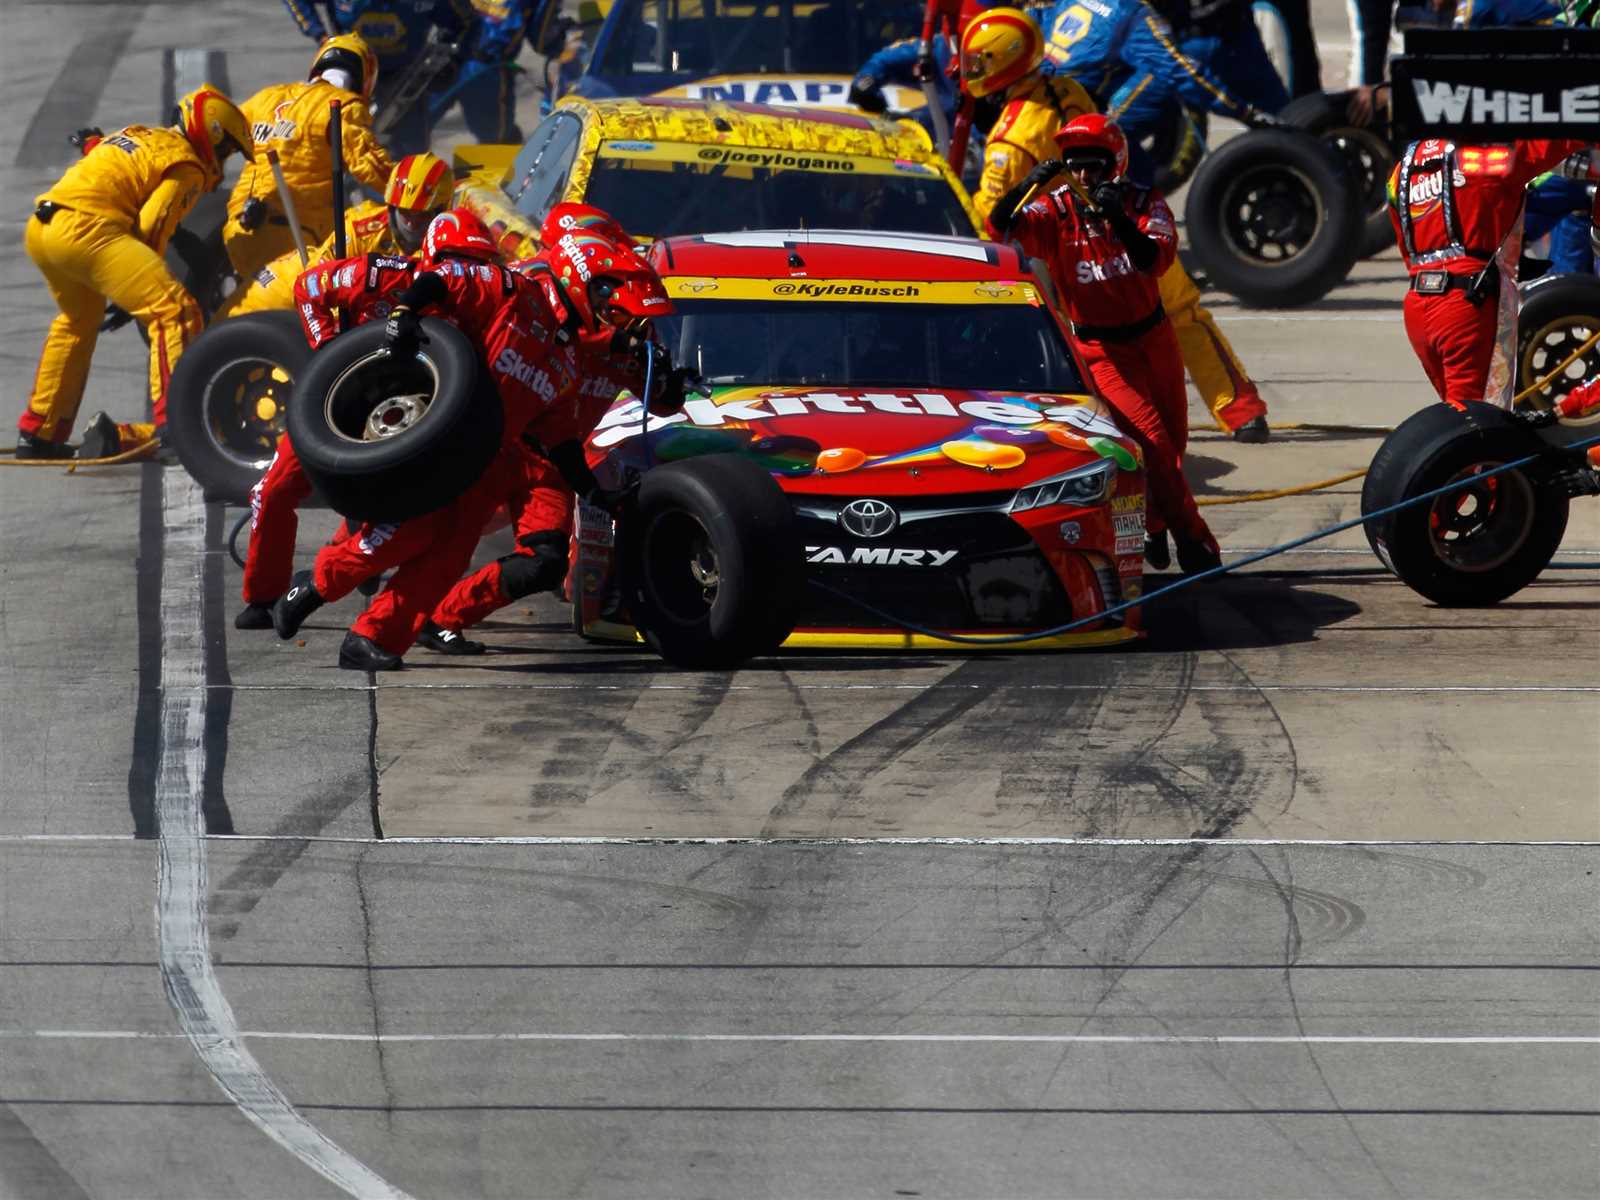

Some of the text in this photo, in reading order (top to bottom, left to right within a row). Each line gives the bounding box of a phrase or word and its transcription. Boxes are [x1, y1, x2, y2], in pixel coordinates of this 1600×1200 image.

[700, 83, 845, 106] NAP
[1411, 78, 1600, 124] WHELE
[697, 148, 855, 172] @joeylogano
[558, 233, 592, 283] Skittles
[772, 283, 920, 298] @KyleBusch
[592, 393, 1124, 448] Skittles
